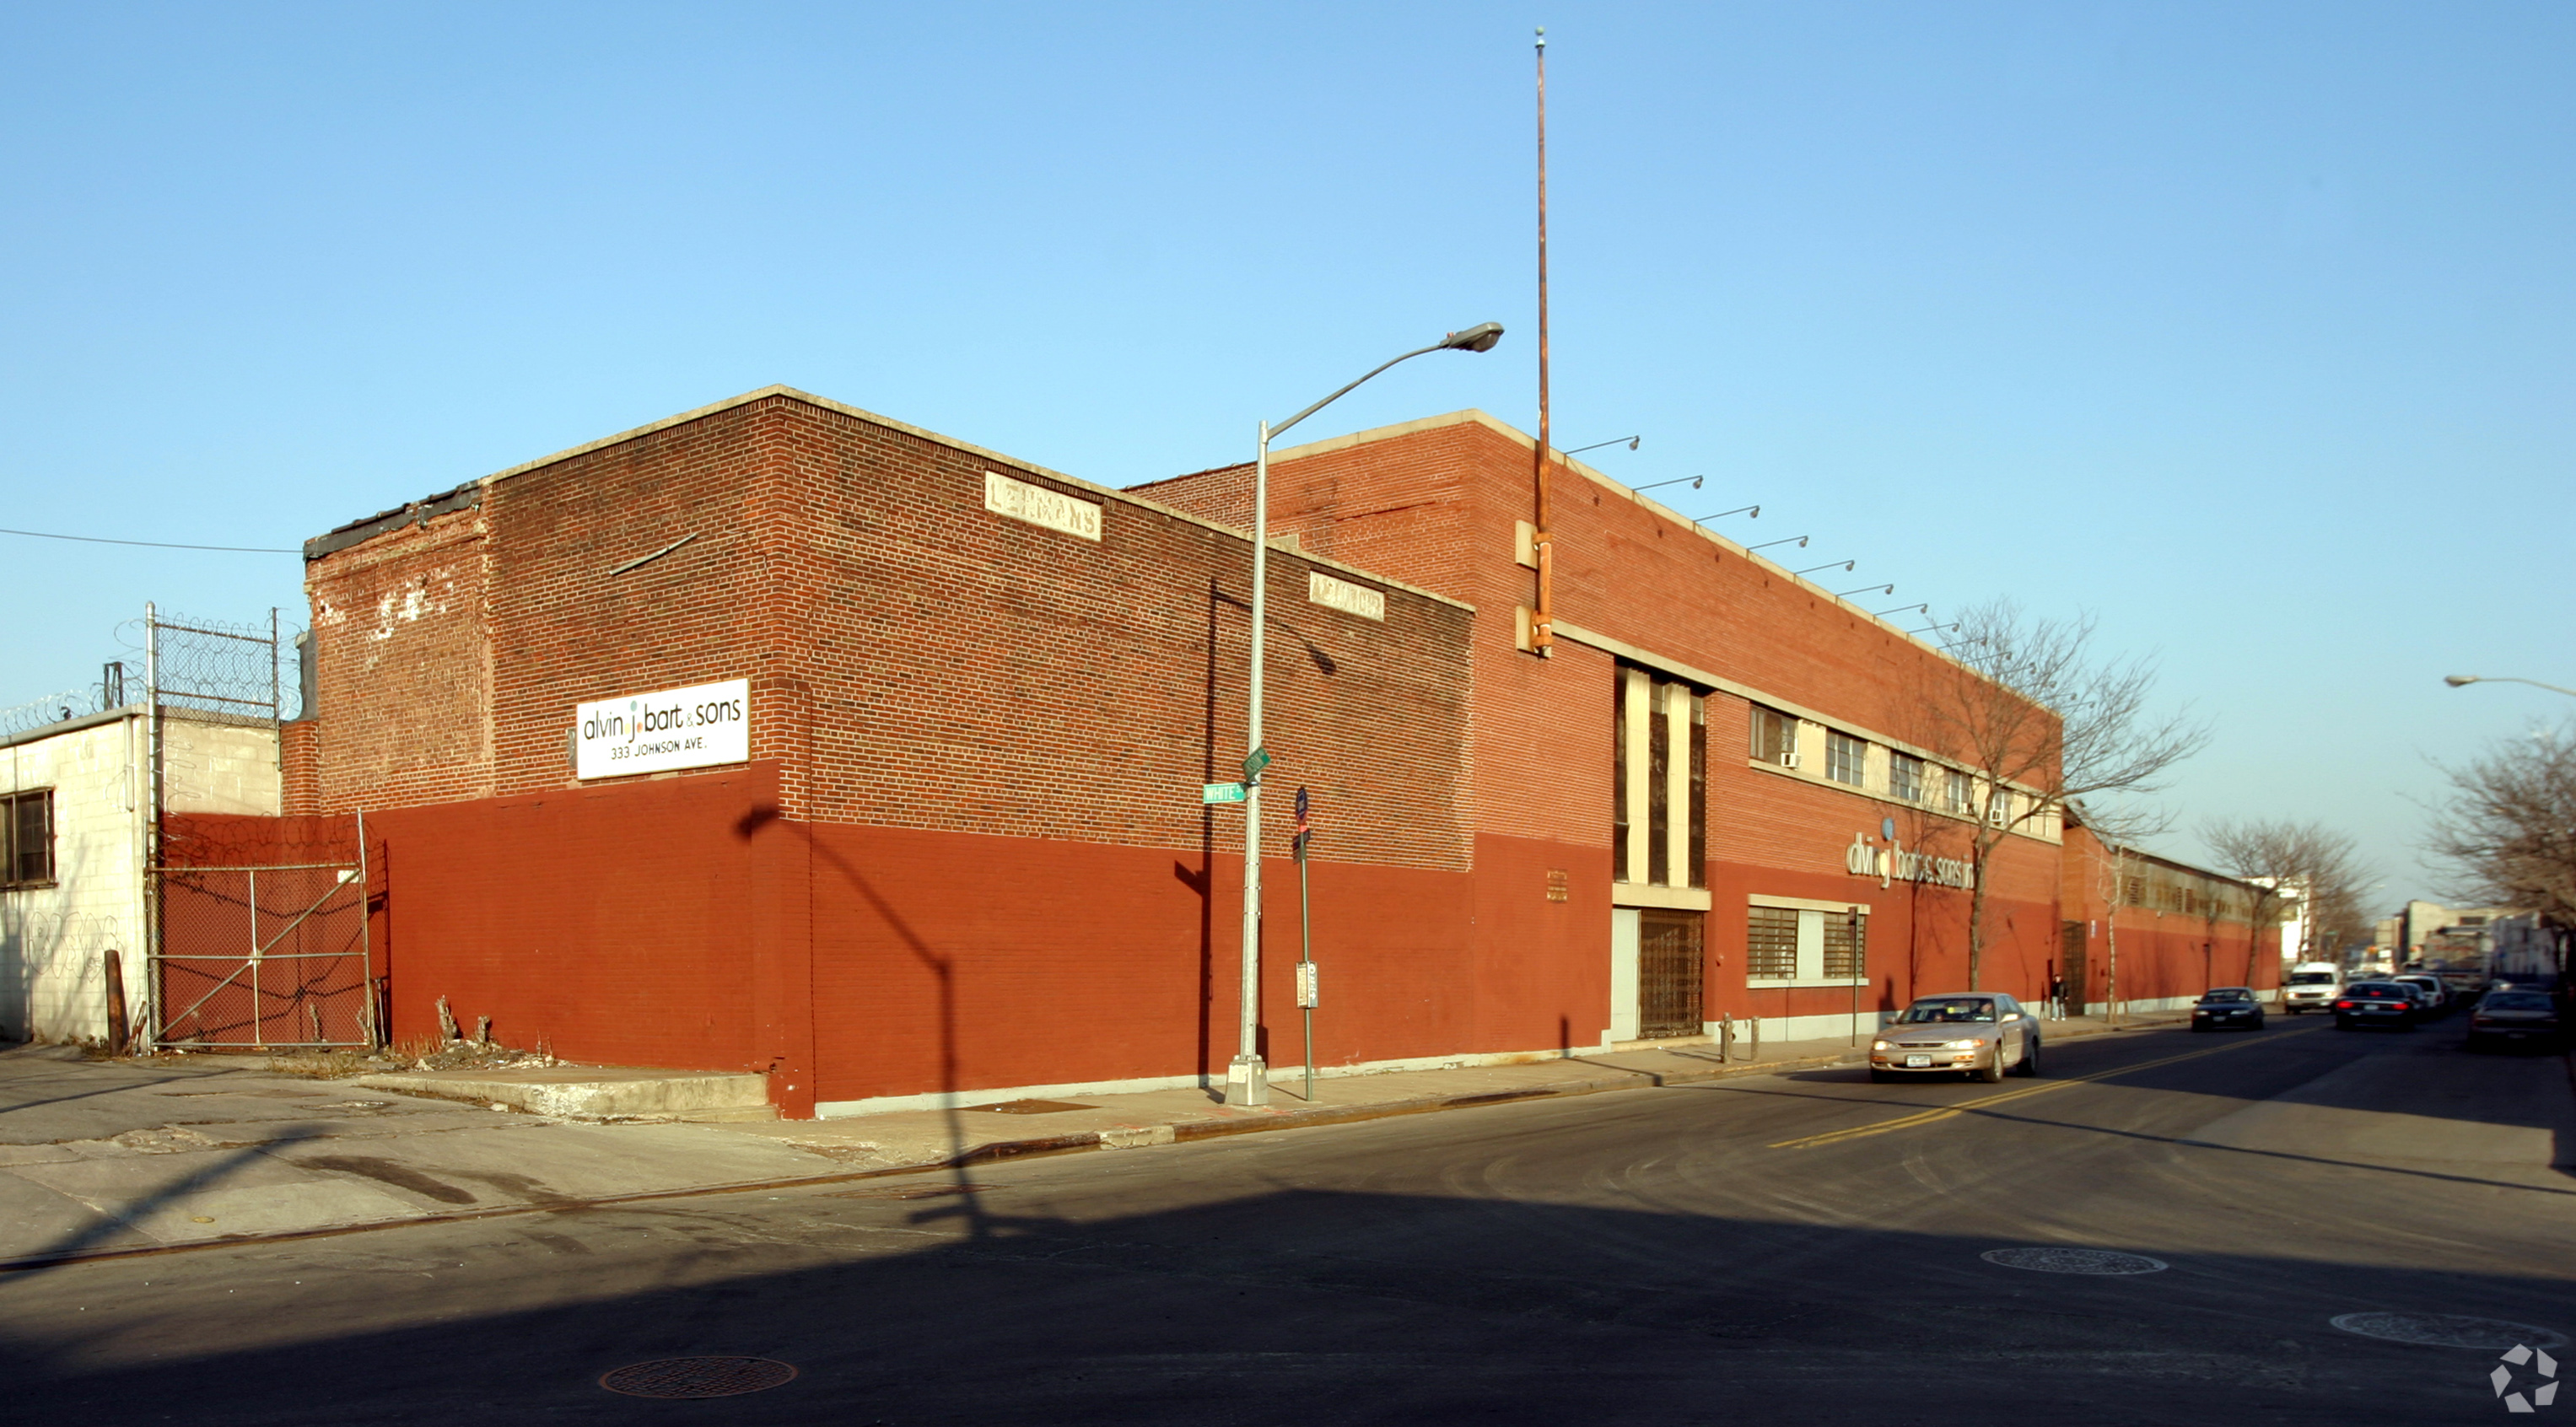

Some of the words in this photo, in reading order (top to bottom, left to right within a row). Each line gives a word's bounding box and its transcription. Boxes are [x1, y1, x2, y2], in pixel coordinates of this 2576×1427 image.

[585, 710, 623, 740] alvin
[644, 703, 683, 732] bart
[686, 713, 695, 728] &
[696, 699, 741, 726] sons
[611, 746, 630, 760] 333
[634, 740, 680, 757] JOHNSON
[684, 736, 707, 751] AVE.
[1205, 785, 1236, 800] WHITE
